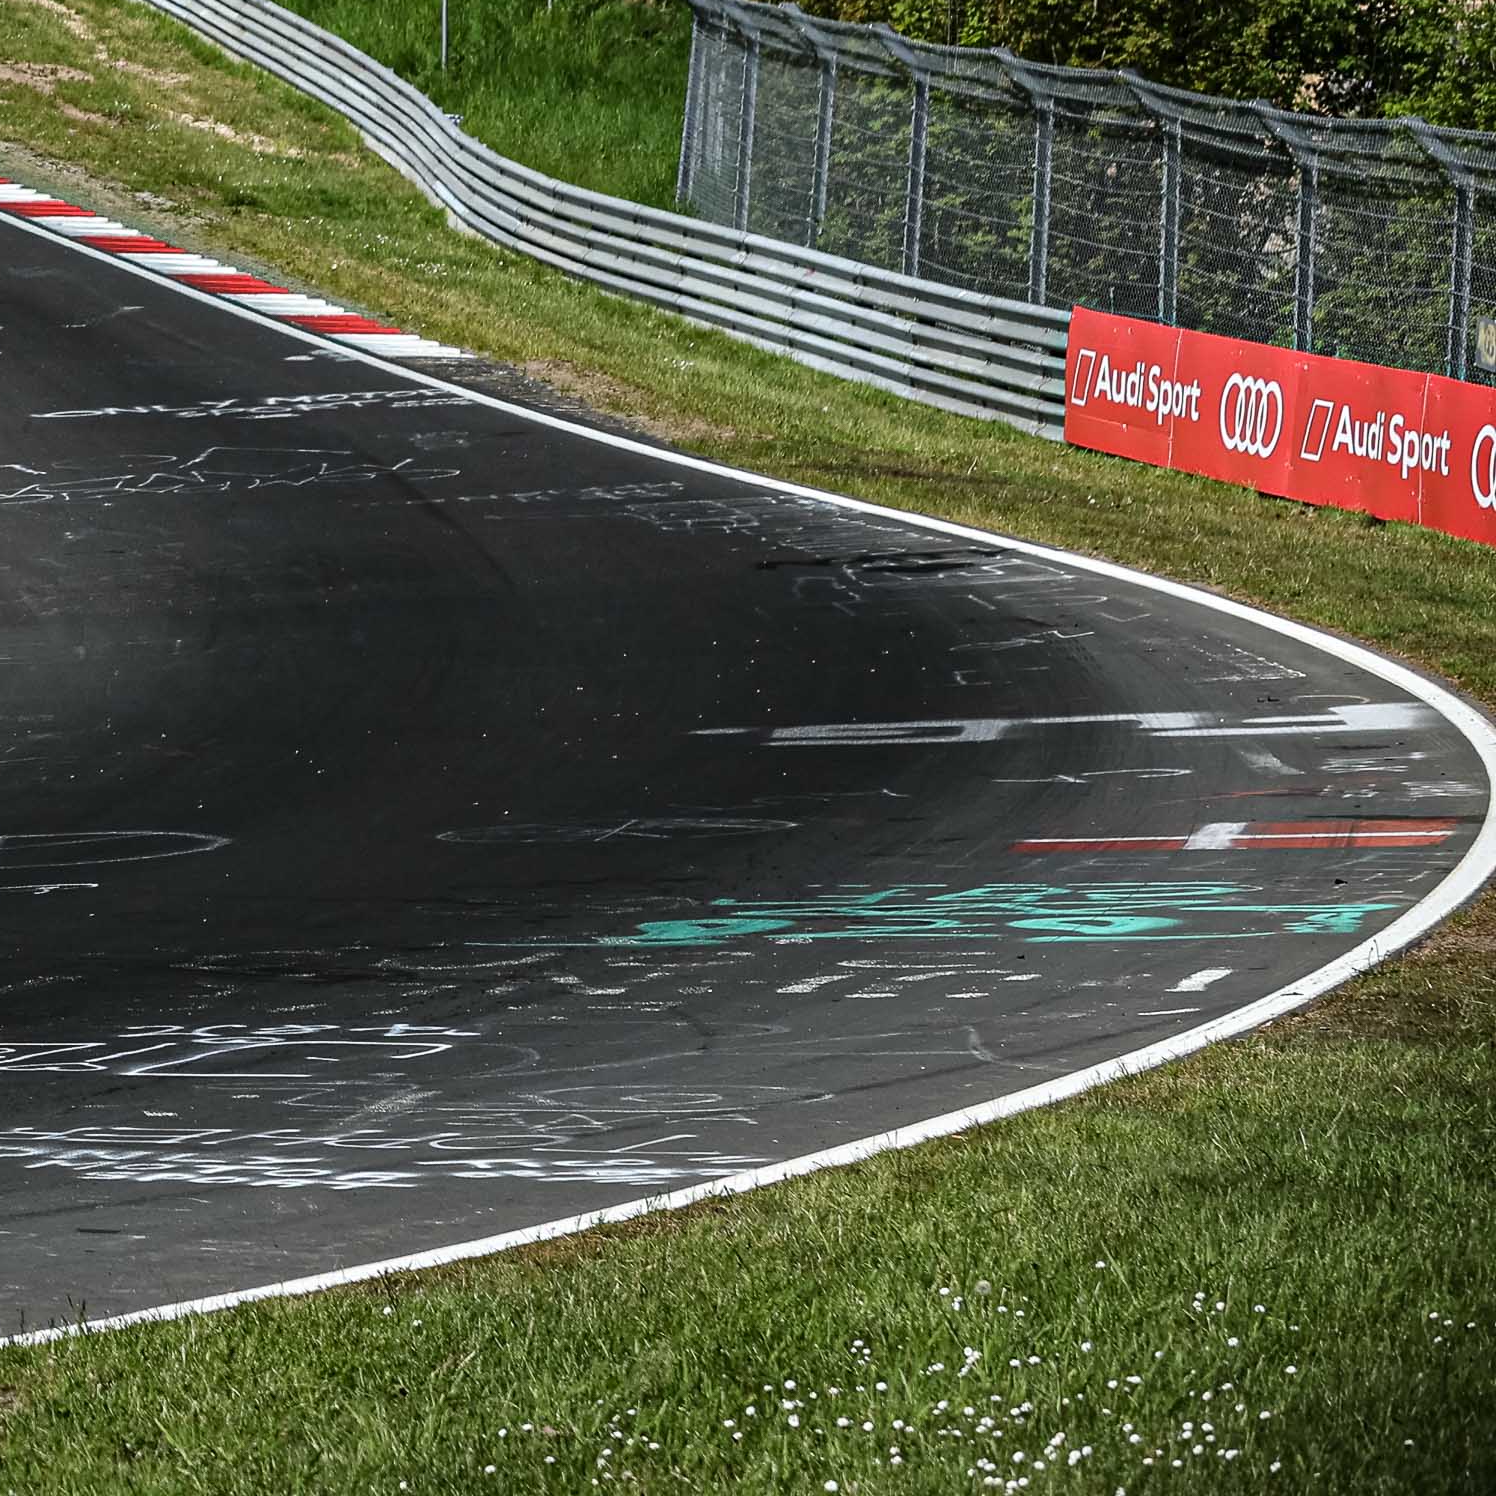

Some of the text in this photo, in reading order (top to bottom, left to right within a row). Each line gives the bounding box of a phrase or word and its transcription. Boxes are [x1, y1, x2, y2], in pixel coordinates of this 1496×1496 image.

[1093, 354, 1203, 425] Audi Sport
[1331, 405, 1452, 479] Audi Sport
